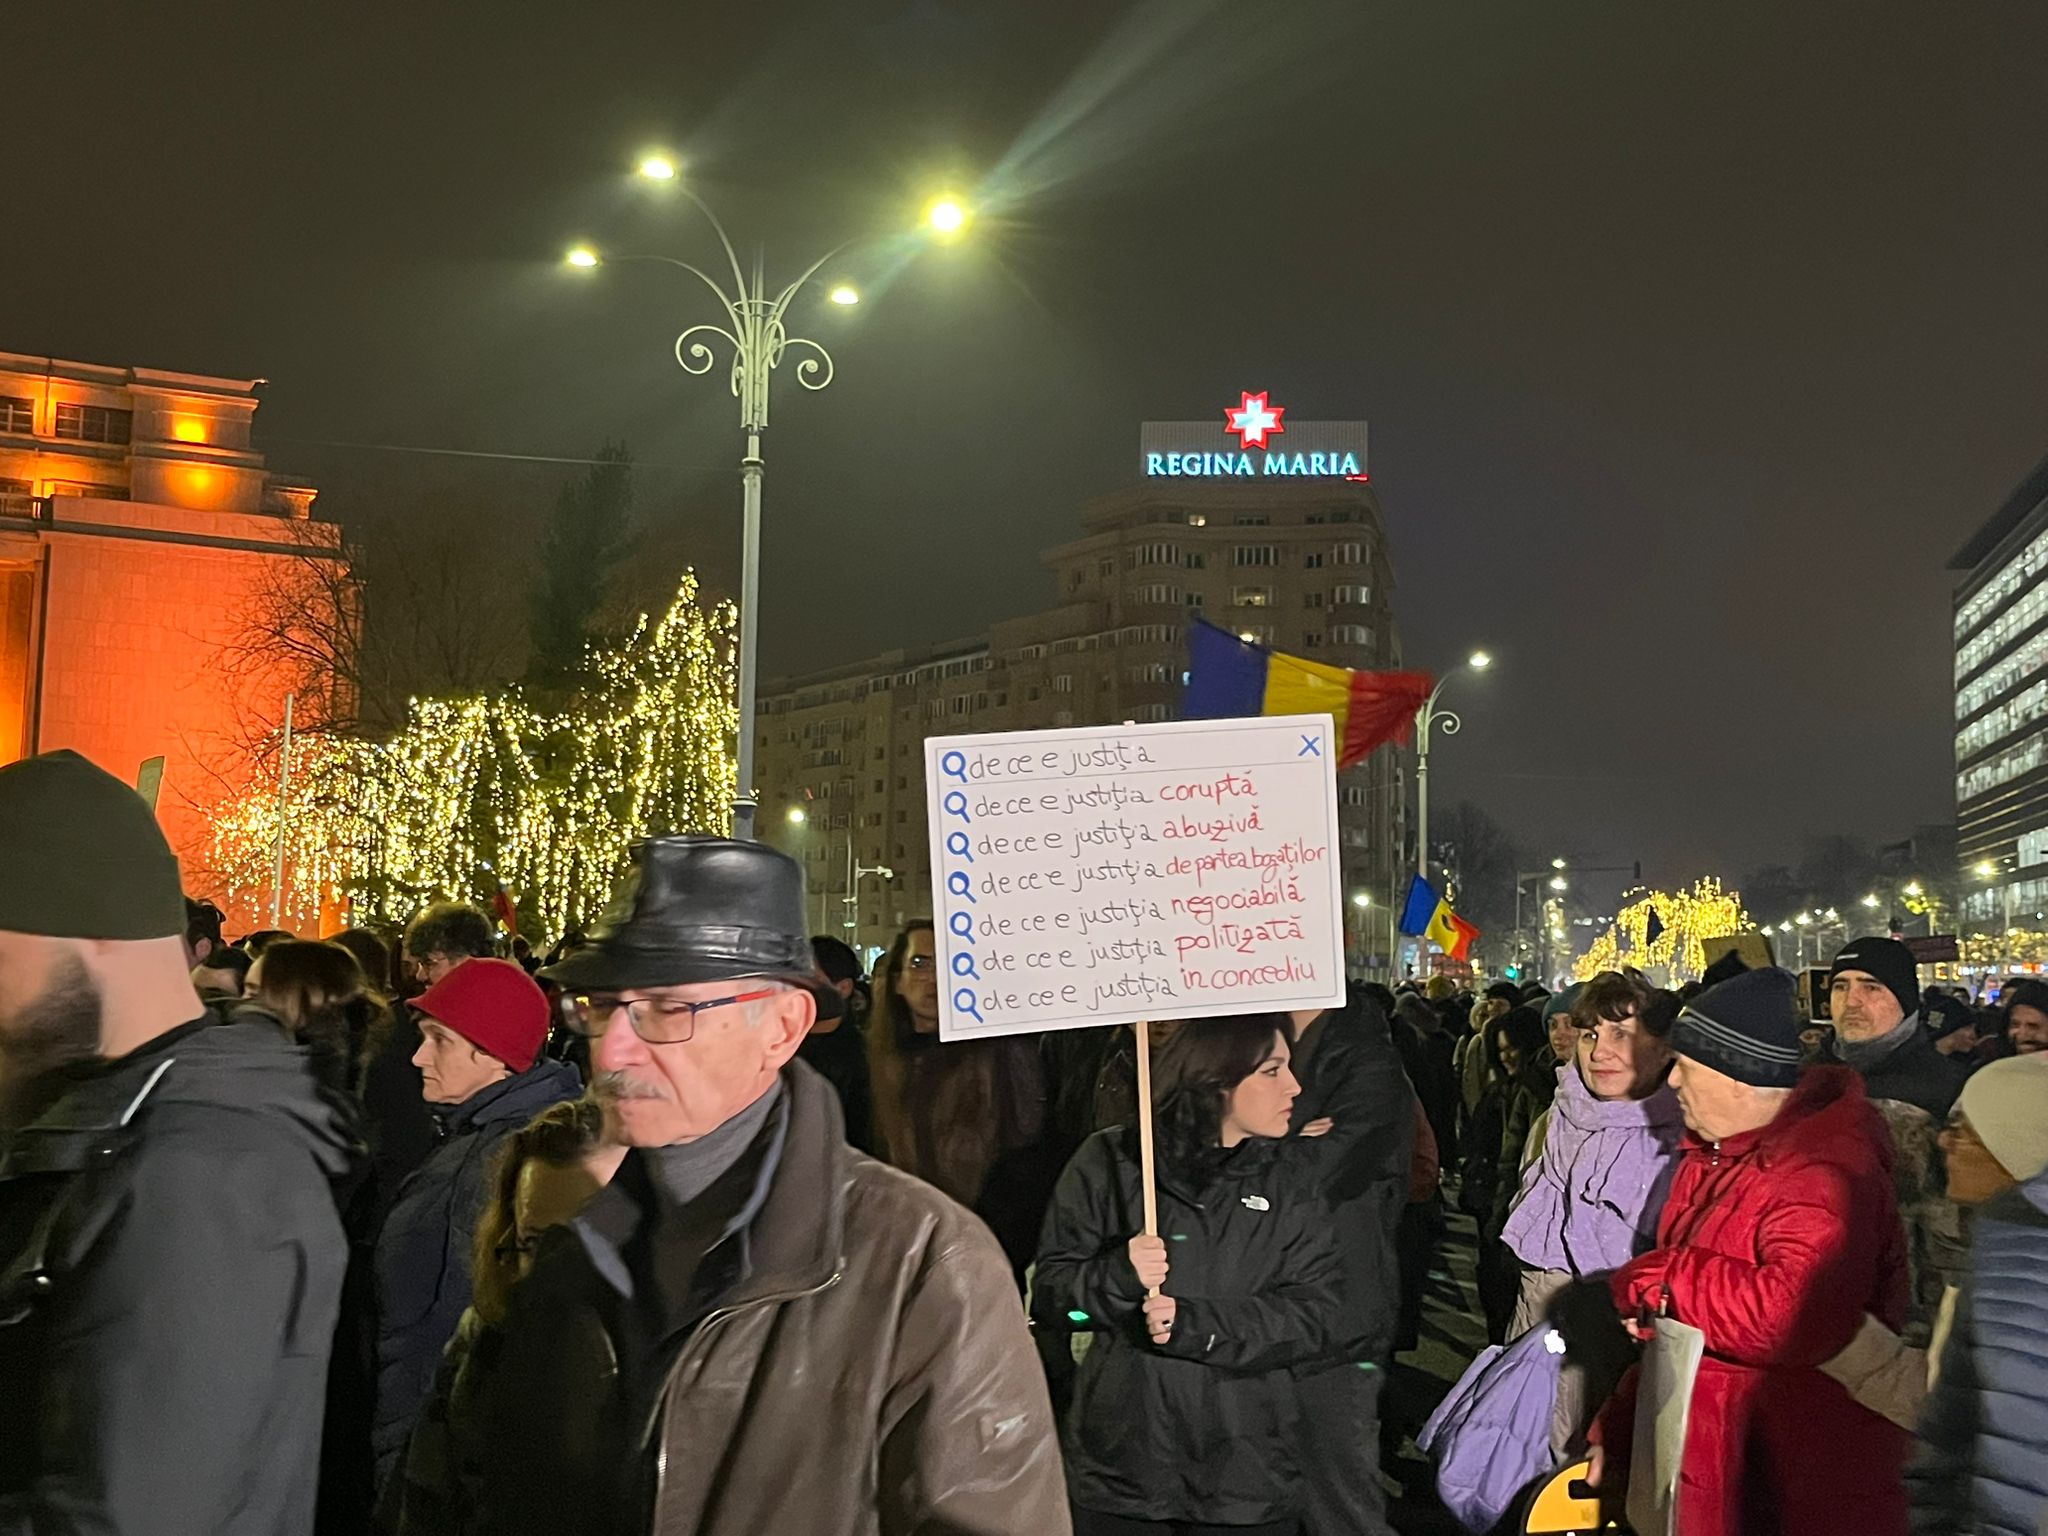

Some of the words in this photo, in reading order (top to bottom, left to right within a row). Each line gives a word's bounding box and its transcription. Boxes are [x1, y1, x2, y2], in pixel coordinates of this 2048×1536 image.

[1147, 452, 1255, 476] REGINA
[1264, 452, 1361, 476] MARIA
[969, 754, 1002, 779] de
[1041, 752, 1059, 768] e
[975, 796, 1003, 817] de
[1006, 797, 1034, 814] ce
[1040, 795, 1059, 810] e
[1062, 782, 1154, 814] justiția
[1160, 770, 1258, 805] coruptă
[978, 834, 1010, 856] de
[1014, 836, 1038, 851] ce
[1044, 832, 1063, 848] e
[1070, 818, 1158, 858] justiția
[1163, 805, 1264, 842] abuzivă
[981, 872, 1012, 896] de
[1044, 869, 1065, 886] e
[1072, 859, 1164, 893] justiția
[1195, 848, 1251, 888] partea
[979, 914, 1014, 937] de
[1021, 915, 1046, 931] ce
[1055, 913, 1070, 929] e
[1078, 898, 1165, 935] justiția
[1171, 875, 1305, 925] negociabilă
[983, 950, 1016, 971] de
[1026, 951, 1051, 968] ce
[1059, 950, 1076, 968] e
[1086, 938, 1167, 969] justiția
[1174, 915, 1304, 963] politizată
[983, 990, 1020, 1011] de
[1028, 990, 1054, 1007] ce
[1061, 985, 1078, 1003] e
[1086, 972, 1178, 1011] justiția
[1211, 955, 1316, 990] concediu
